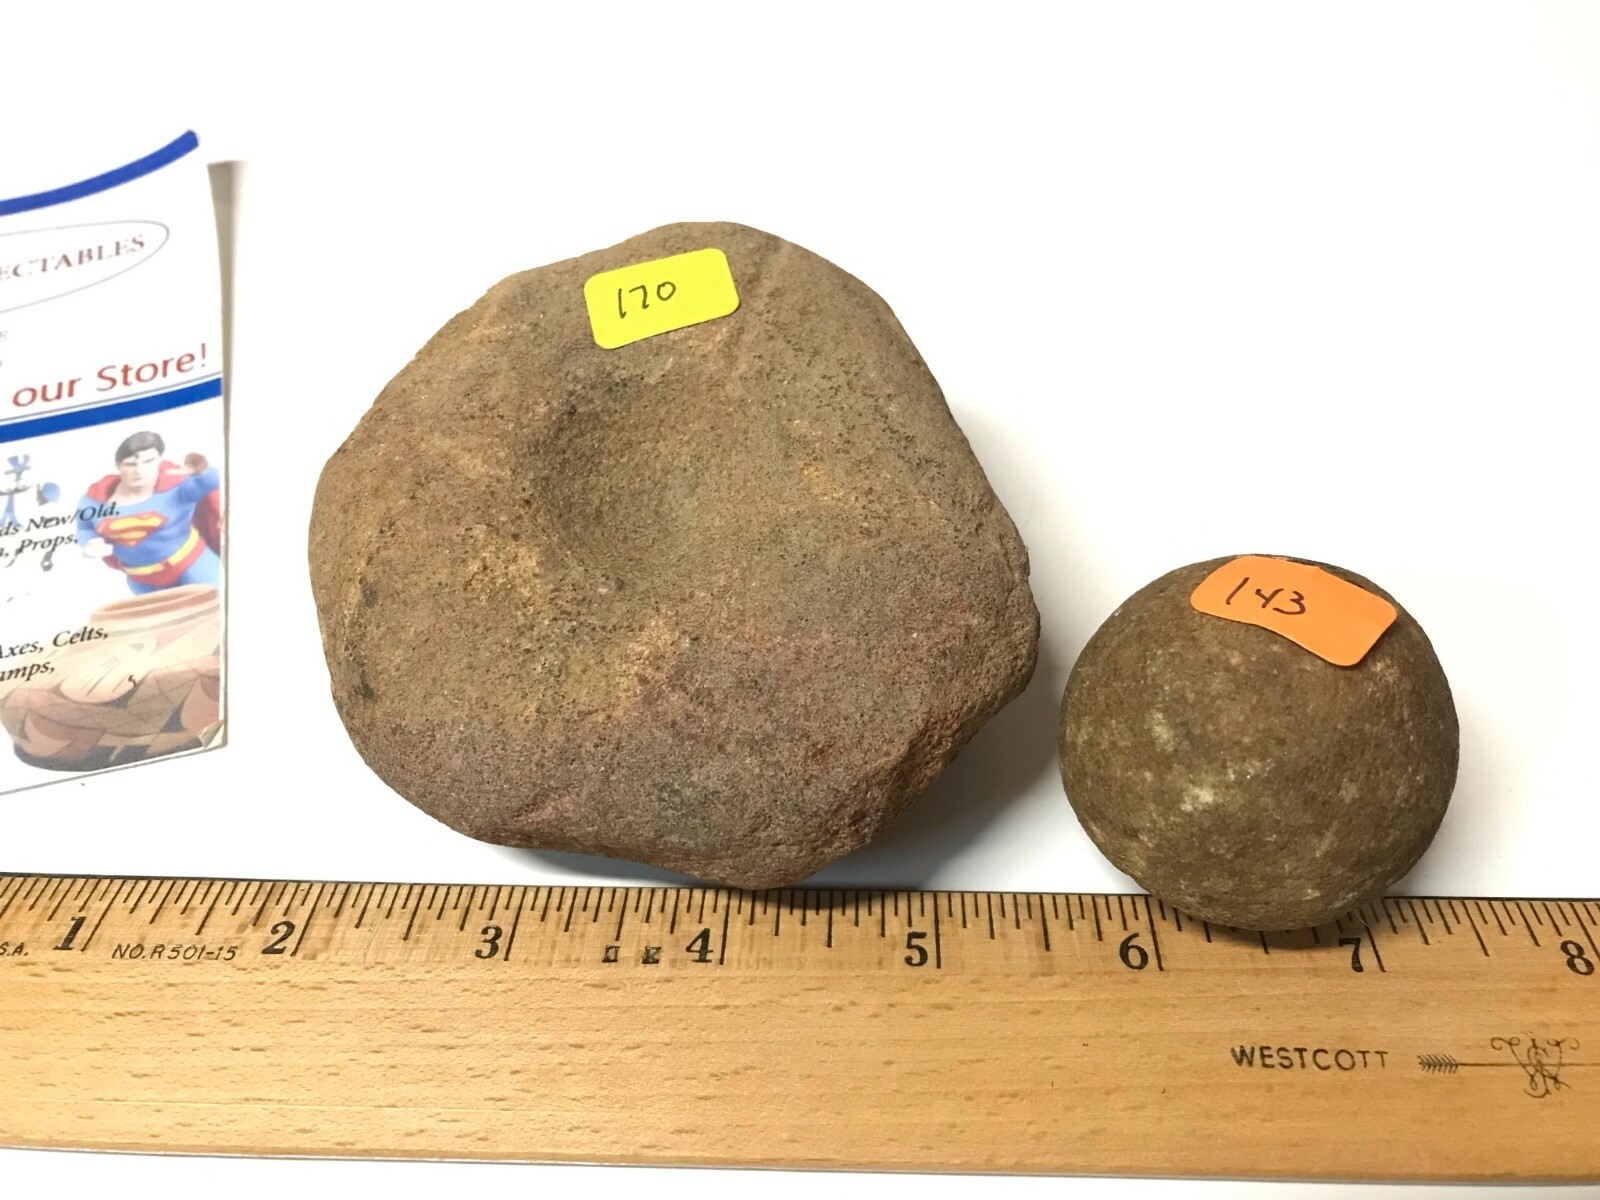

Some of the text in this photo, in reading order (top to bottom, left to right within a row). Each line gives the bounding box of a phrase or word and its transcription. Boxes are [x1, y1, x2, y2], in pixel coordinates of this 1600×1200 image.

[617, 280, 677, 319] 170
[12, 342, 206, 407] our Store!
[1225, 577, 1306, 615] 143
[52, 626, 109, 648] Celts,
[52, 916, 86, 951] 1
[261, 920, 296, 955] 2
[474, 925, 504, 960] 3
[685, 927, 714, 963] 4
[904, 931, 929, 967] 5
[1118, 932, 1149, 970] 6
[1338, 937, 1364, 973] 7
[1560, 940, 1595, 976] 8
[1230, 1045, 1389, 1071] WESTCOTT
